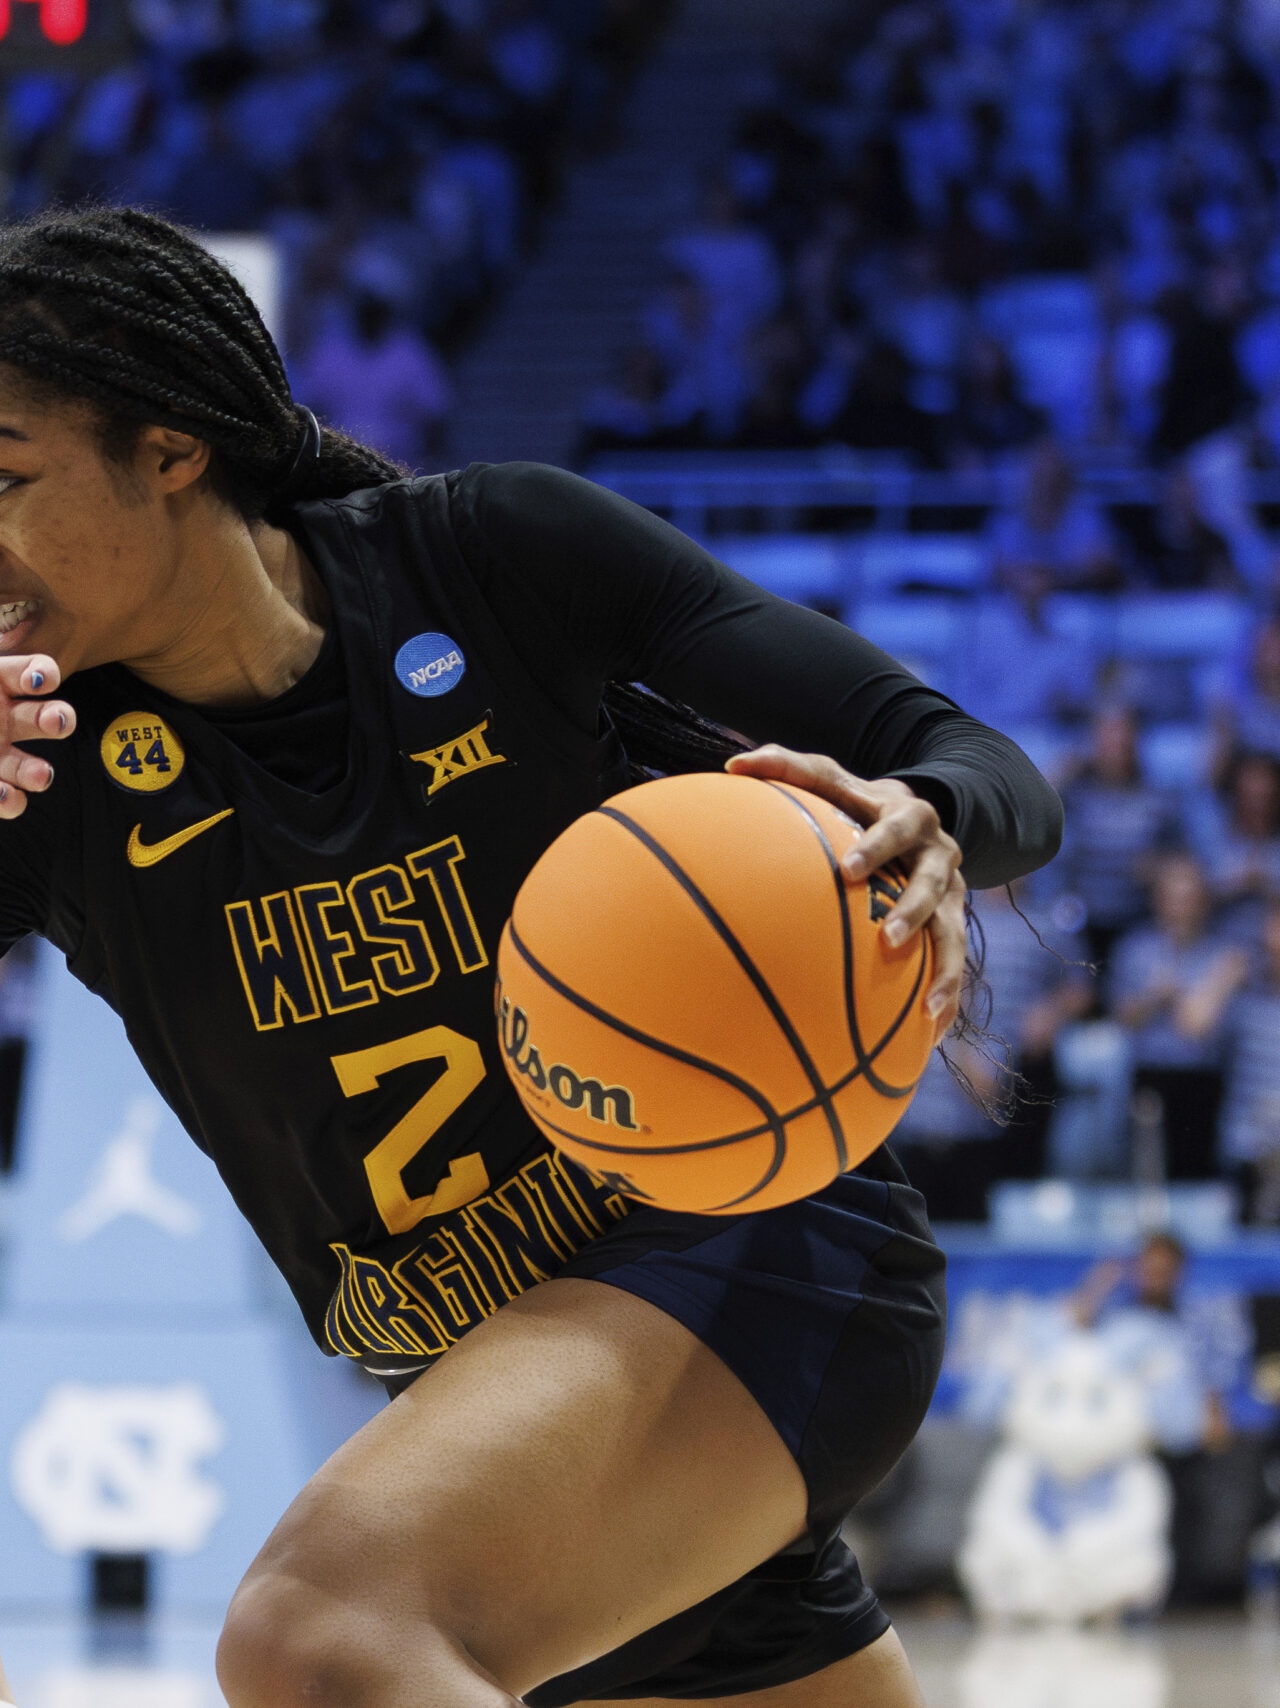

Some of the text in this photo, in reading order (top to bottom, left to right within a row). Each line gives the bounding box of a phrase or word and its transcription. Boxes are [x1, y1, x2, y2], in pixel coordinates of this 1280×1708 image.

[408, 650, 463, 688] NCAA
[115, 739, 172, 775] 44
[116, 725, 163, 743] WEST
[409, 718, 507, 796] XII
[223, 834, 489, 1032] WEST
[494, 990, 640, 1132] ilson
[330, 1024, 490, 1236] 2
